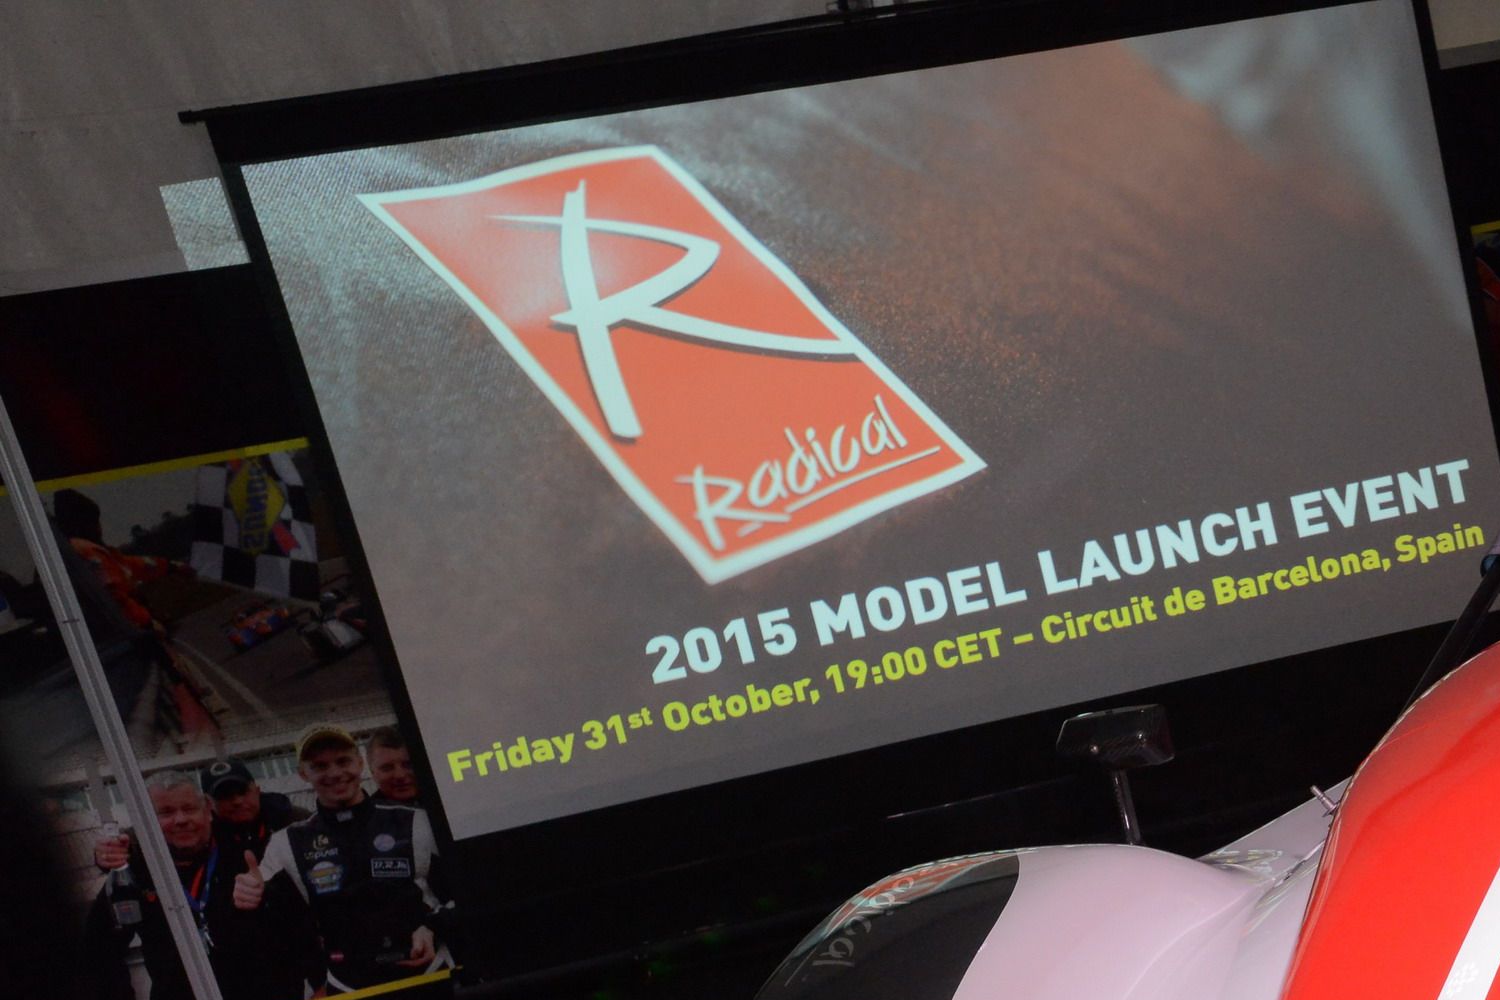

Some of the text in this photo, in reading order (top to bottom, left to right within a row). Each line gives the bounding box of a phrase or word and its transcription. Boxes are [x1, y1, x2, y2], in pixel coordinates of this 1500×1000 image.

[487, 180, 862, 441] R
[645, 607, 798, 684] 2015
[809, 561, 1027, 645] MODEL
[1038, 501, 1278, 594] LAUNCH
[1290, 459, 1470, 538] EVENT
[674, 394, 910, 550] Radical
[447, 733, 575, 782] Friday
[582, 706, 654, 751] 31st
[661, 676, 821, 732] October,
[824, 645, 928, 694] 19:00
[932, 627, 1003, 670] CET
[1040, 594, 1158, 644] Circuit
[1163, 586, 1206, 617] de
[1211, 547, 1392, 606] Barcelona,
[1394, 522, 1485, 564] Spain
